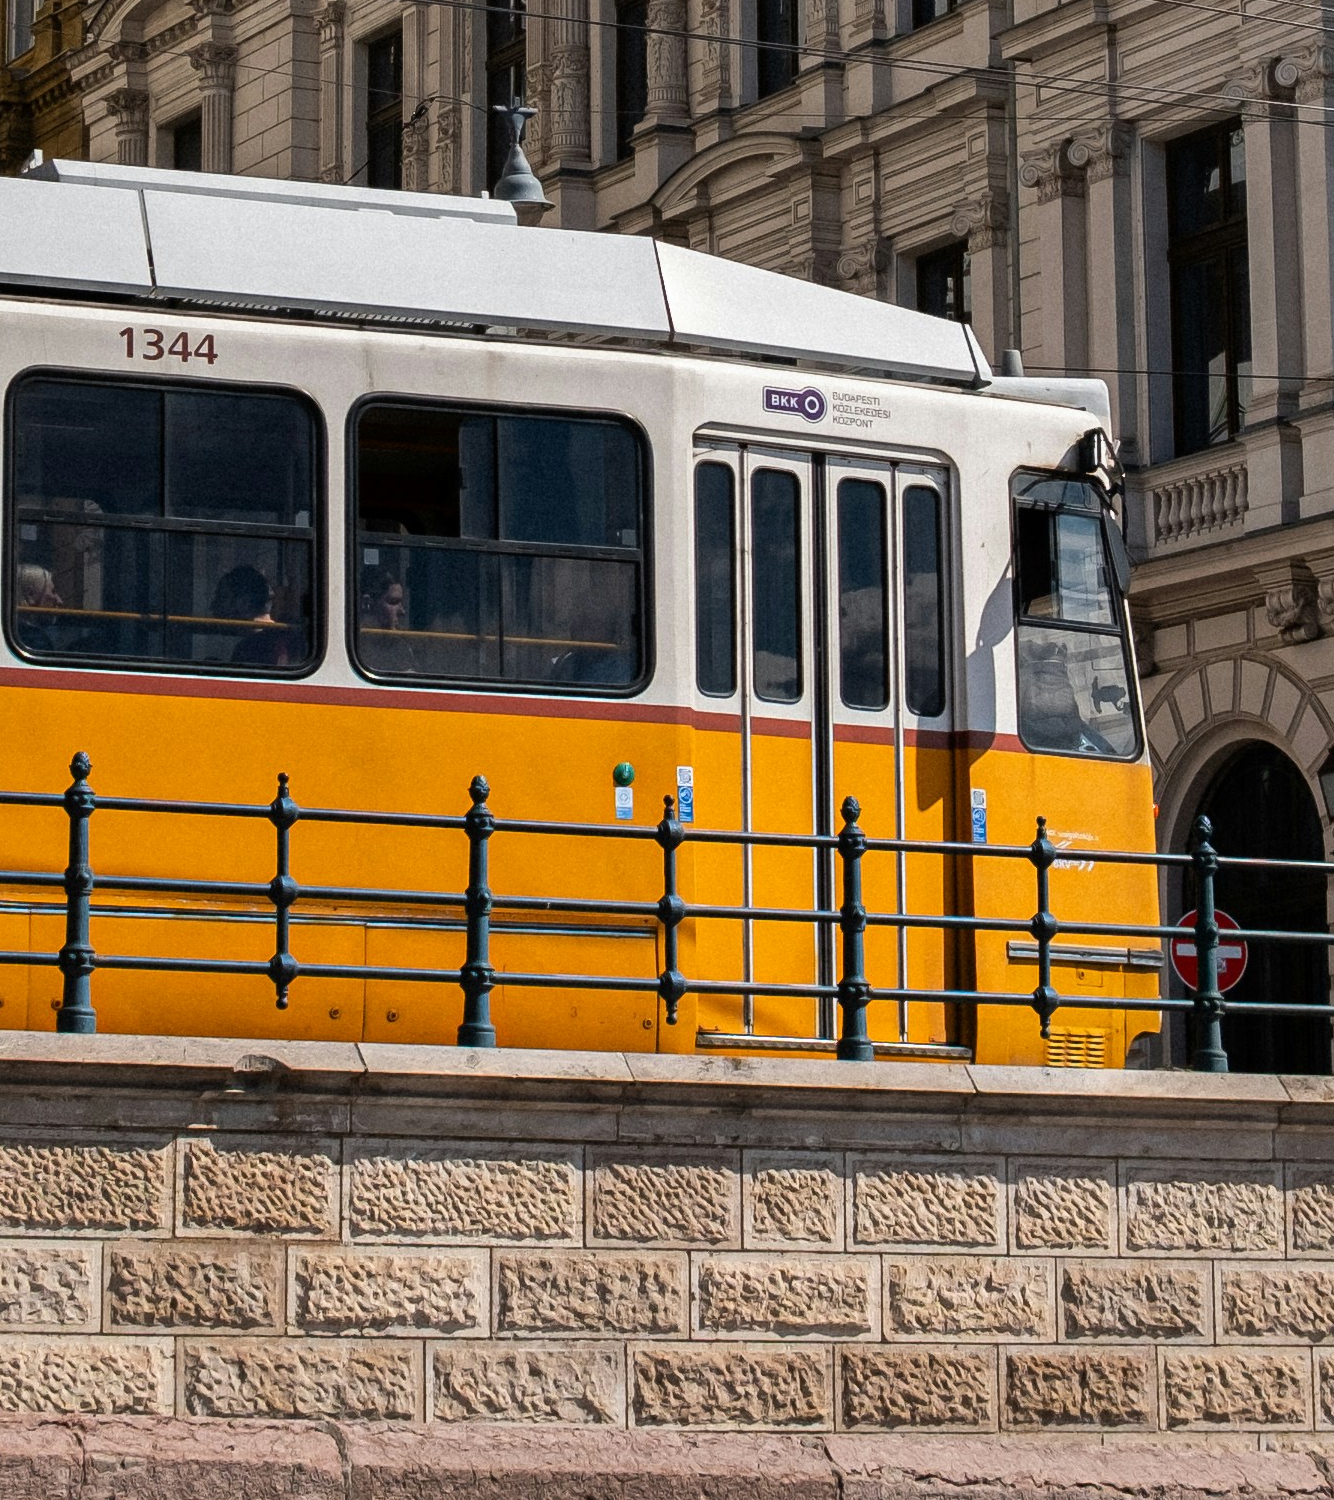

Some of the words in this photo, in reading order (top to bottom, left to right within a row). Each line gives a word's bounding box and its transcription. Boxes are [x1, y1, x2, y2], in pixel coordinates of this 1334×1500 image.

[119, 327, 218, 365] 1344
[771, 394, 798, 409] BKK
[832, 392, 880, 406] BUDAPESTI
[832, 415, 873, 428] KÖZPONT
